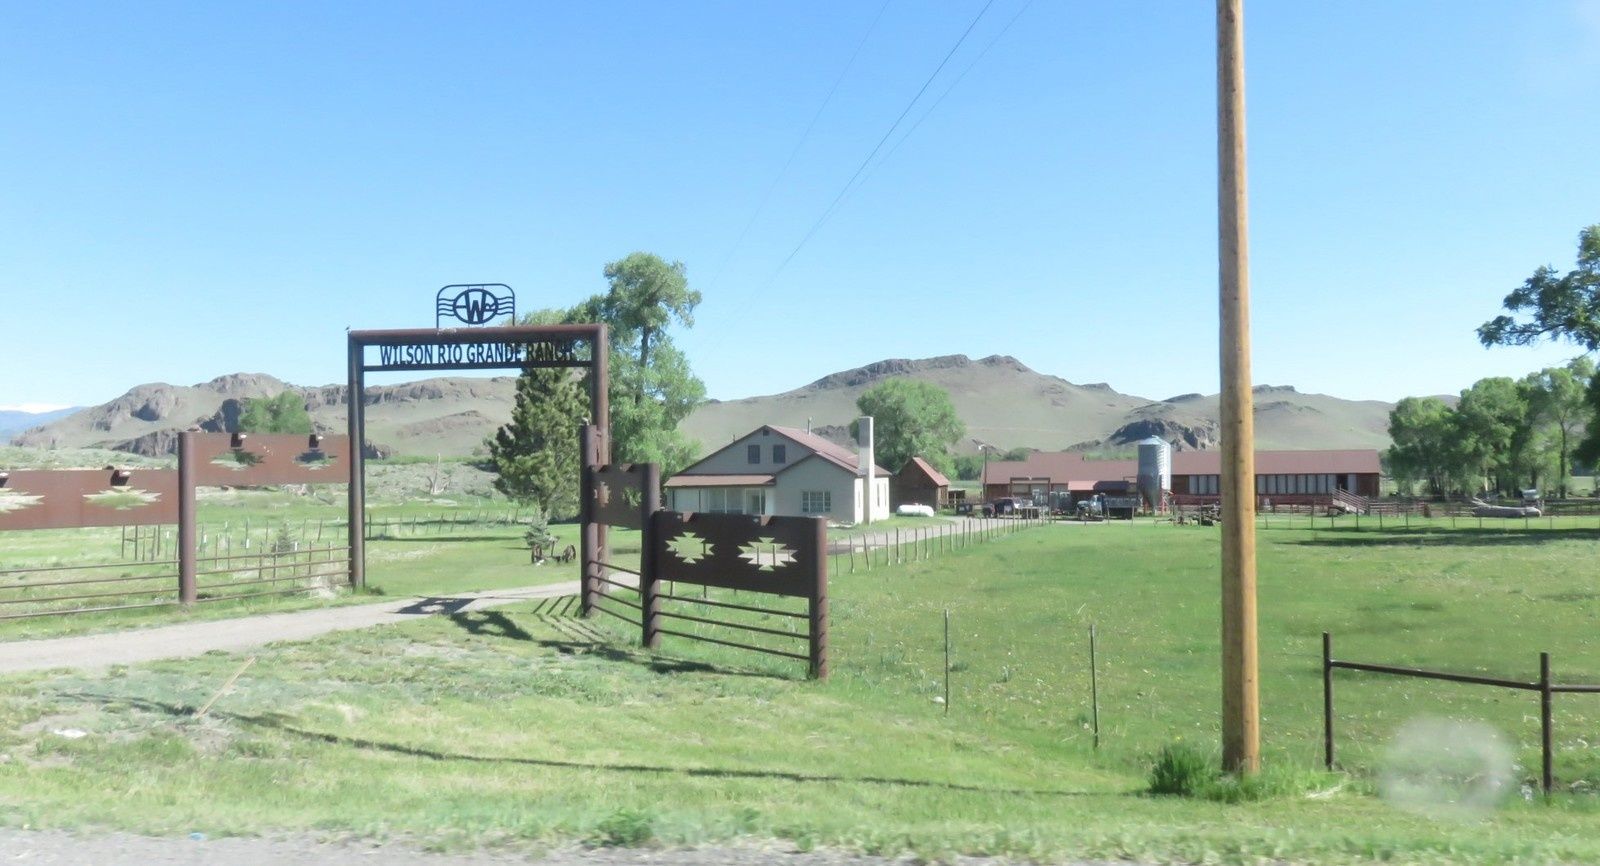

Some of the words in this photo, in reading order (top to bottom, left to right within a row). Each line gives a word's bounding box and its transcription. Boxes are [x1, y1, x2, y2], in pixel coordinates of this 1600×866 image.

[380, 344, 433, 365] WILSON
[438, 344, 463, 363] RIO
[466, 343, 523, 362] GRANDE
[526, 341, 575, 361] RANCH
